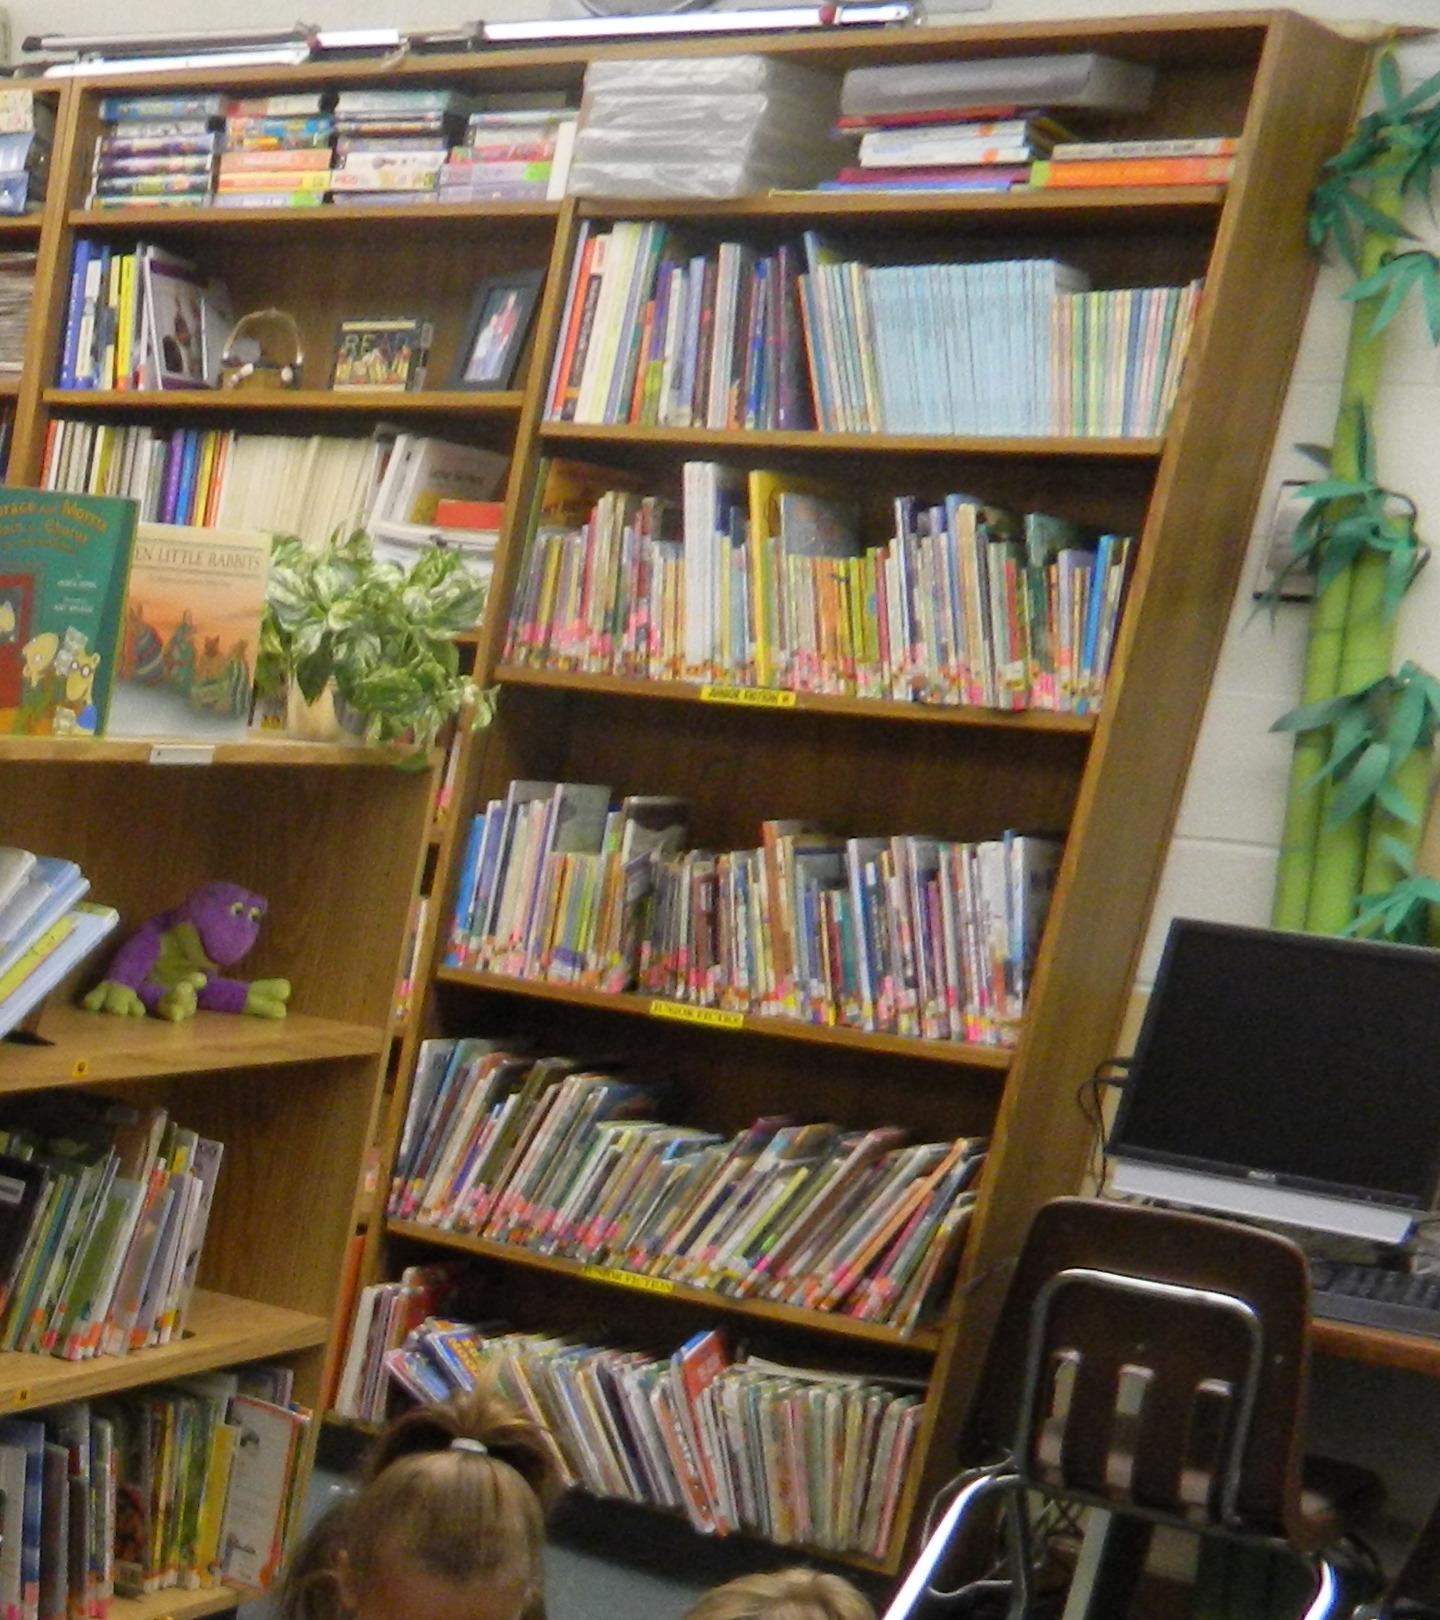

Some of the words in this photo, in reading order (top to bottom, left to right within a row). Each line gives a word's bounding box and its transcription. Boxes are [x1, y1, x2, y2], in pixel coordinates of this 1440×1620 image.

[134, 547, 154, 562] EN
[157, 548, 204, 567] LITTLE
[207, 550, 261, 571] RABBITS
